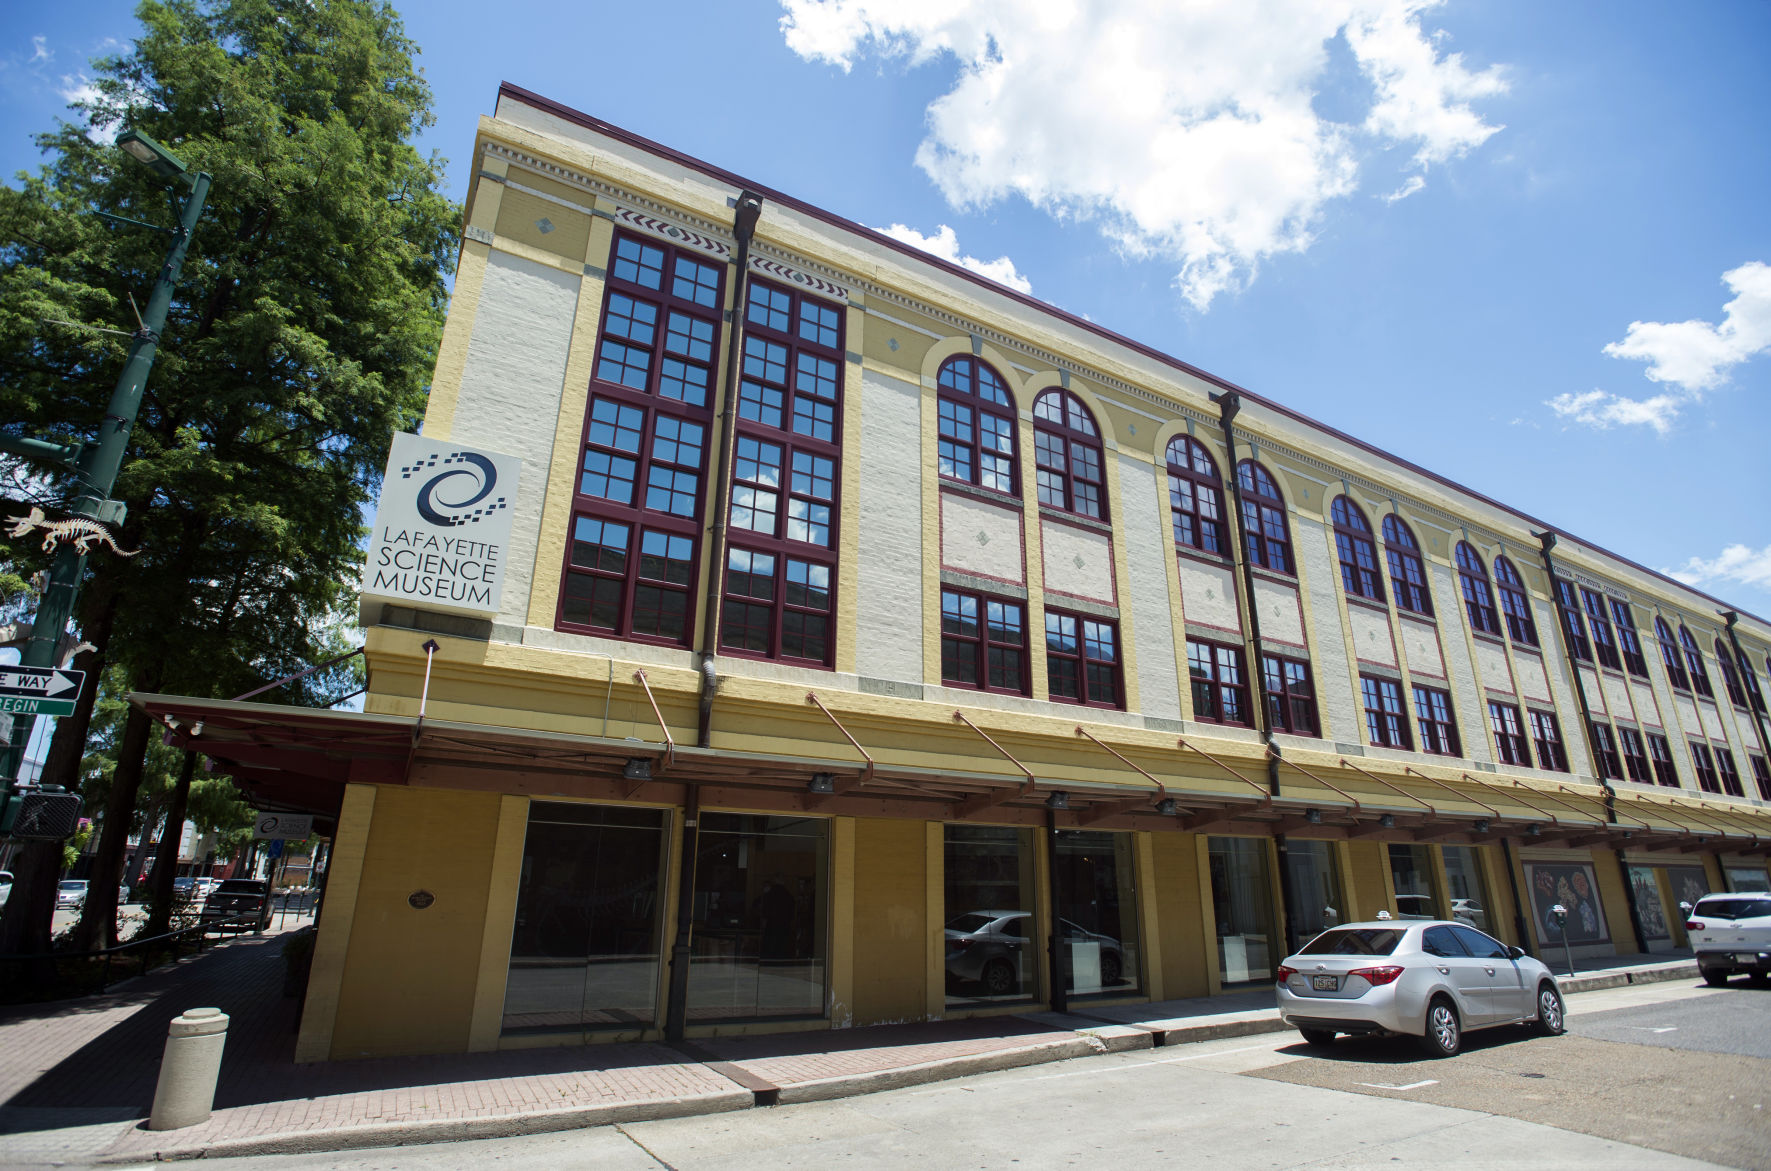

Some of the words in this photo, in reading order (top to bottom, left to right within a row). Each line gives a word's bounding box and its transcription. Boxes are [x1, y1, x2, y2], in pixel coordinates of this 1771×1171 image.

[383, 526, 499, 561] LAFAYETTE
[377, 546, 497, 583] SCIENCE
[373, 569, 491, 605] MUSEUM
[17, 675, 53, 689] WAY
